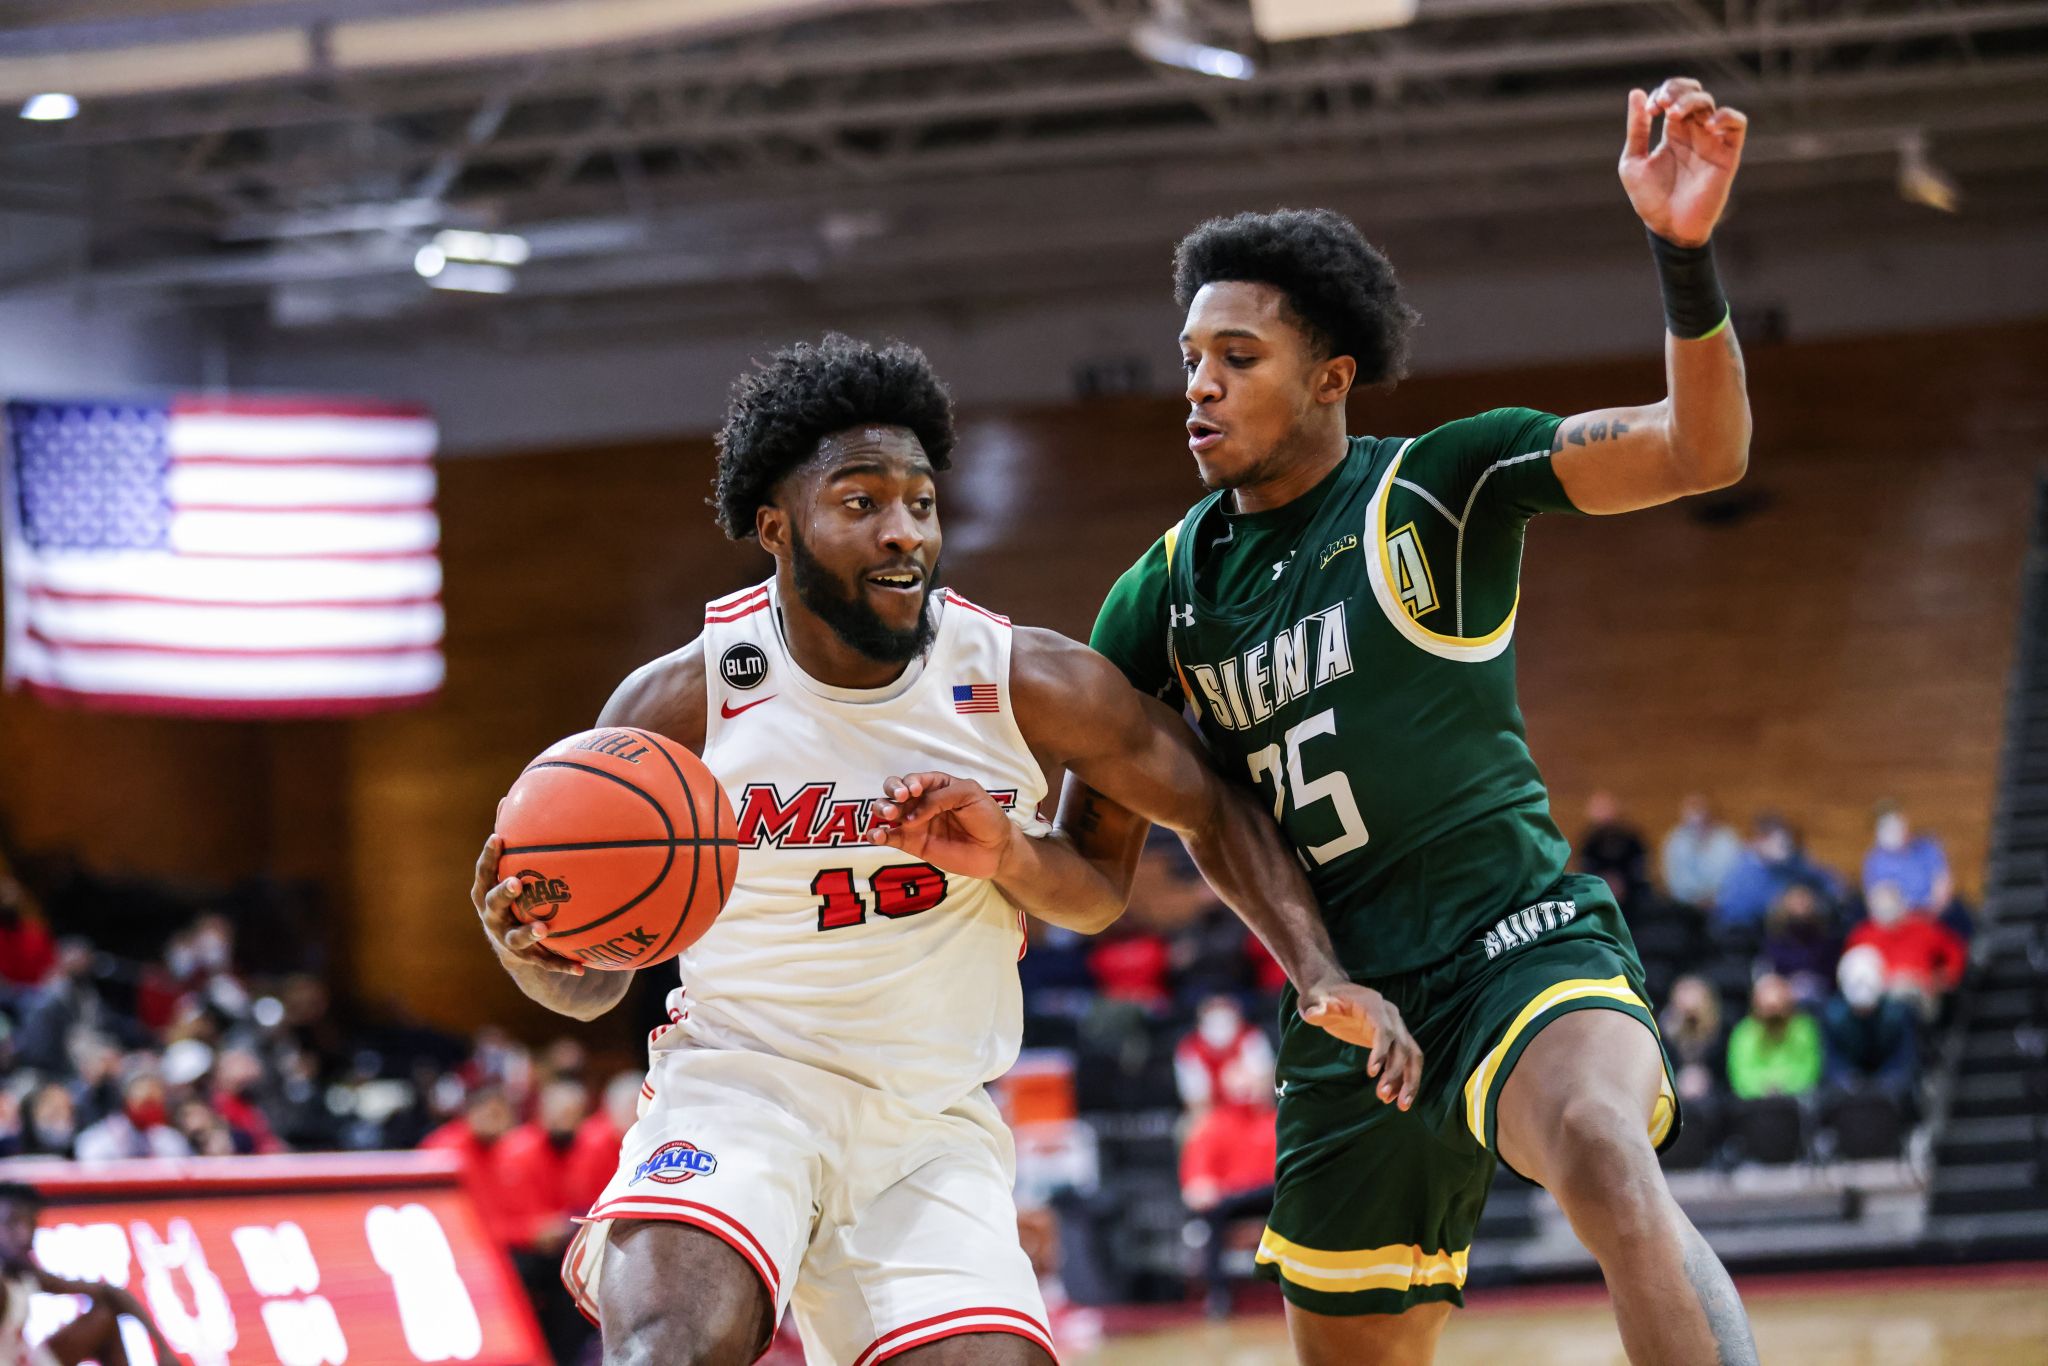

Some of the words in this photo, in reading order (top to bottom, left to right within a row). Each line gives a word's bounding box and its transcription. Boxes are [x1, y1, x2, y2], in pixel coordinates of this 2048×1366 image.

[1320, 534, 1358, 570] MAAC
[725, 658, 763, 677] BLM
[1185, 600, 1354, 732] SIENA
[810, 862, 948, 932] 10
[1484, 900, 1576, 961] SAINTS
[629, 1149, 717, 1187] MAAC
